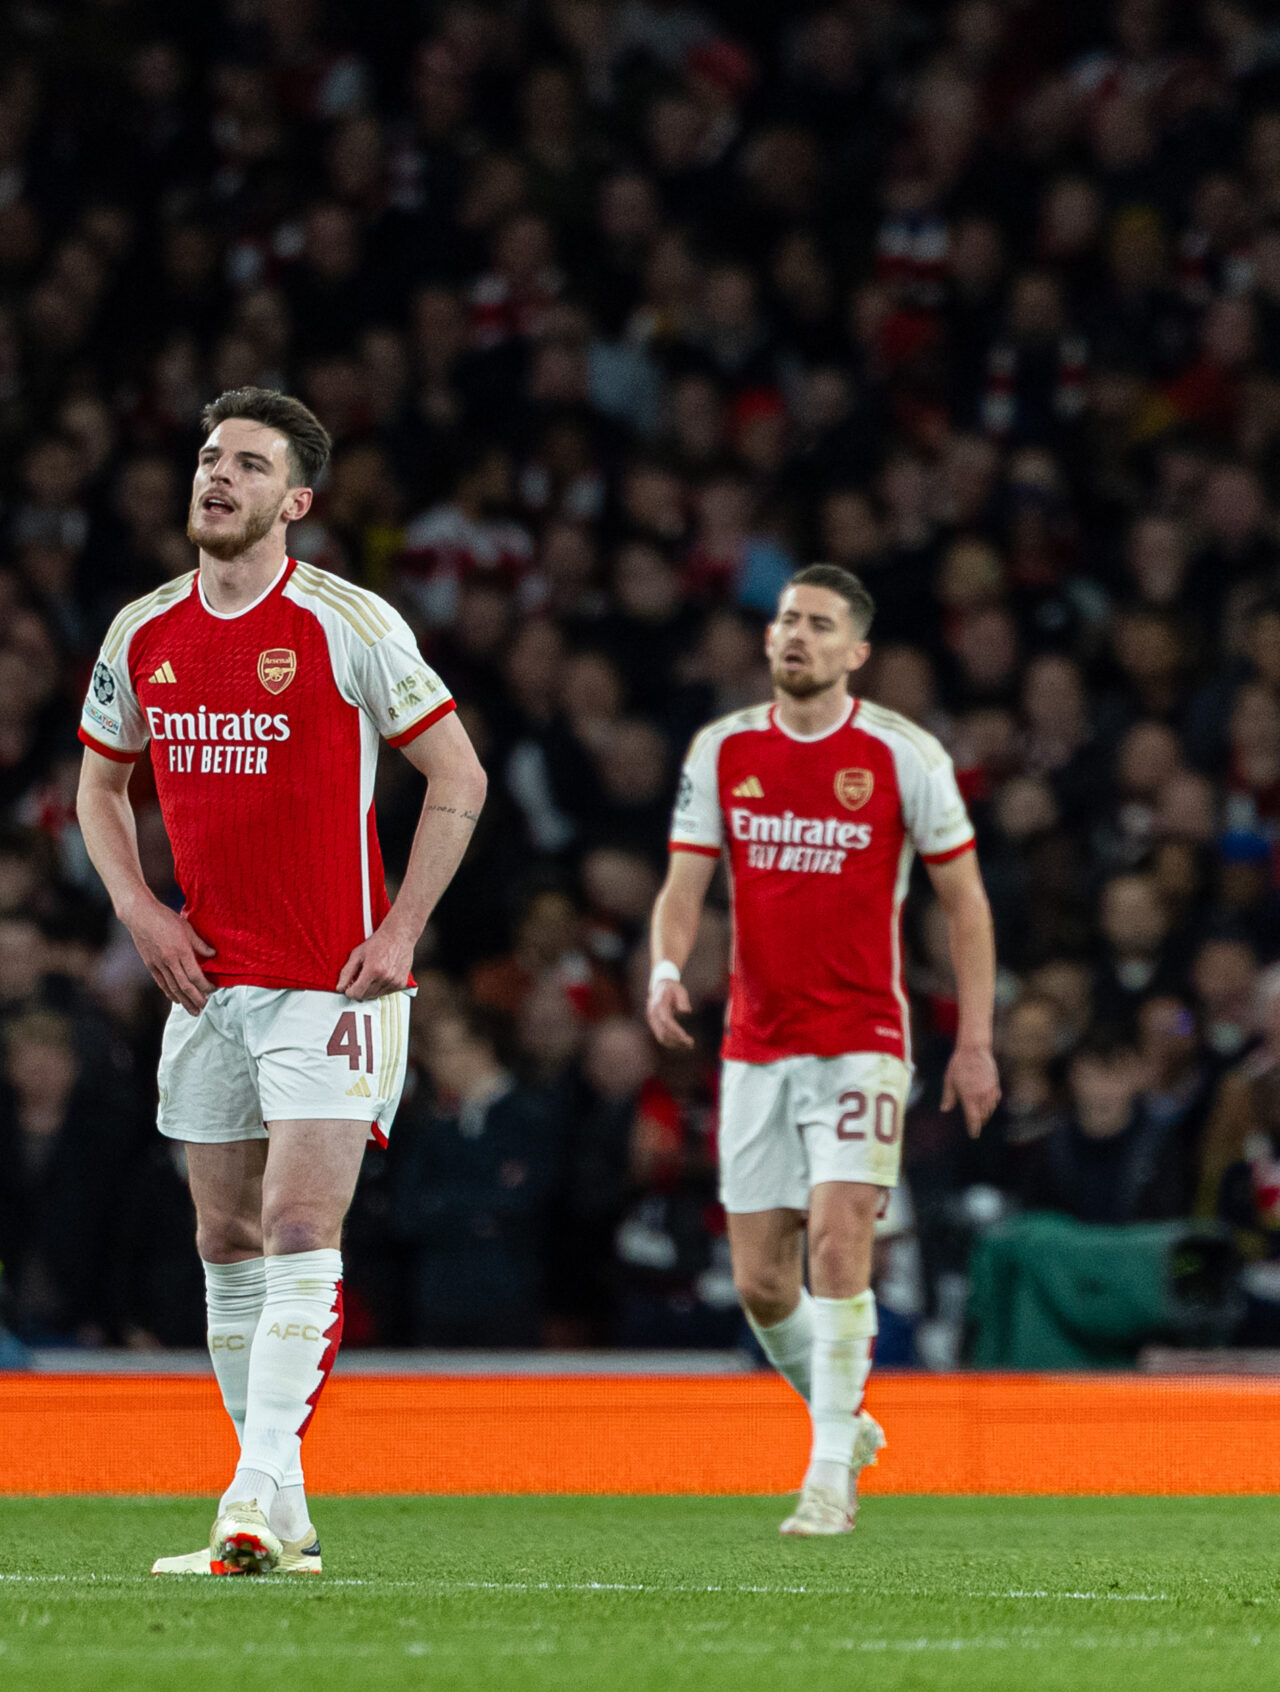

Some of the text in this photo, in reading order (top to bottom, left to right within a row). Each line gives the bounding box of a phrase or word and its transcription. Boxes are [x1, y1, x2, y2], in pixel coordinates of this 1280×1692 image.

[264, 656, 292, 664] Arsenal
[146, 705, 291, 742] Emirates
[169, 745, 268, 775] FLY BETTER
[731, 808, 872, 850] Emirates
[326, 1011, 373, 1074] 41
[837, 1091, 898, 1144] 20
[211, 1334, 246, 1354] FC
[267, 1321, 321, 1342] AFC
